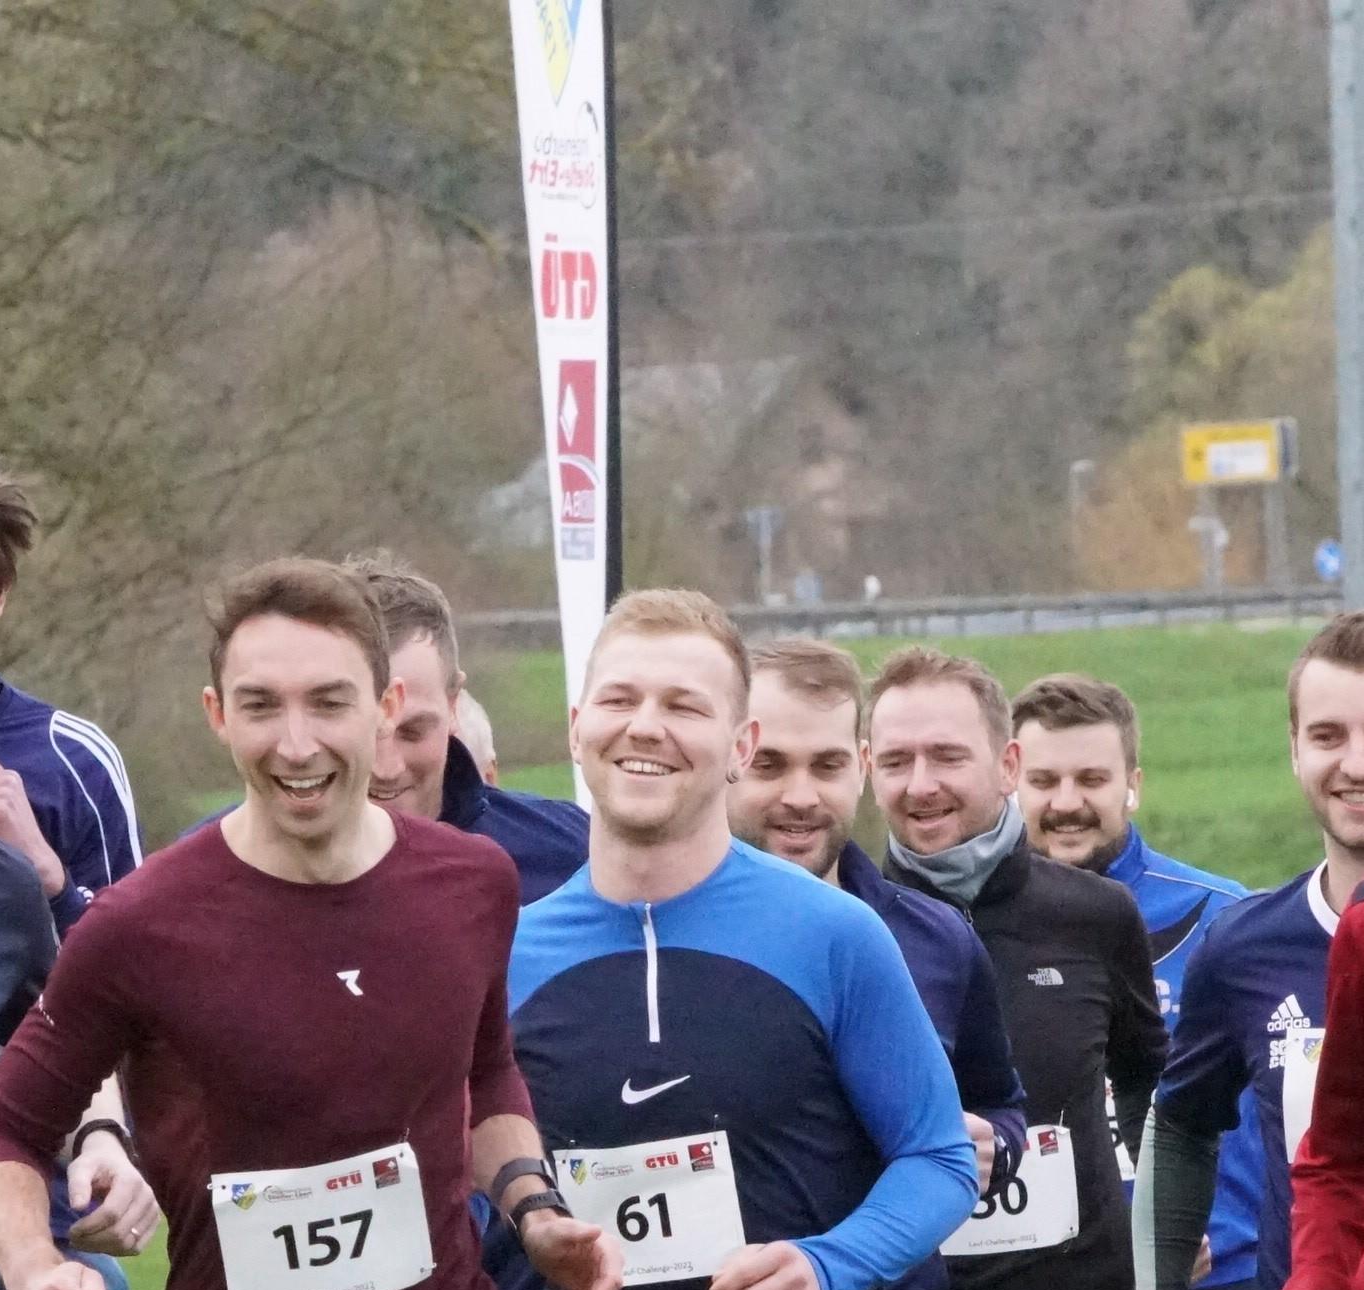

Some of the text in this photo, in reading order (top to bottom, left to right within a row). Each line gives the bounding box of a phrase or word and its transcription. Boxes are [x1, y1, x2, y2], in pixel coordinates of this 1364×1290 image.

[1266, 1016, 1311, 1033] adidas
[645, 1152, 679, 1169] GTÜ
[326, 1170, 363, 1191] GTÜ
[616, 1192, 672, 1242] 61
[273, 1208, 373, 1270] 157
[623, 1261, 694, 1277] auf-Challenge-2023
